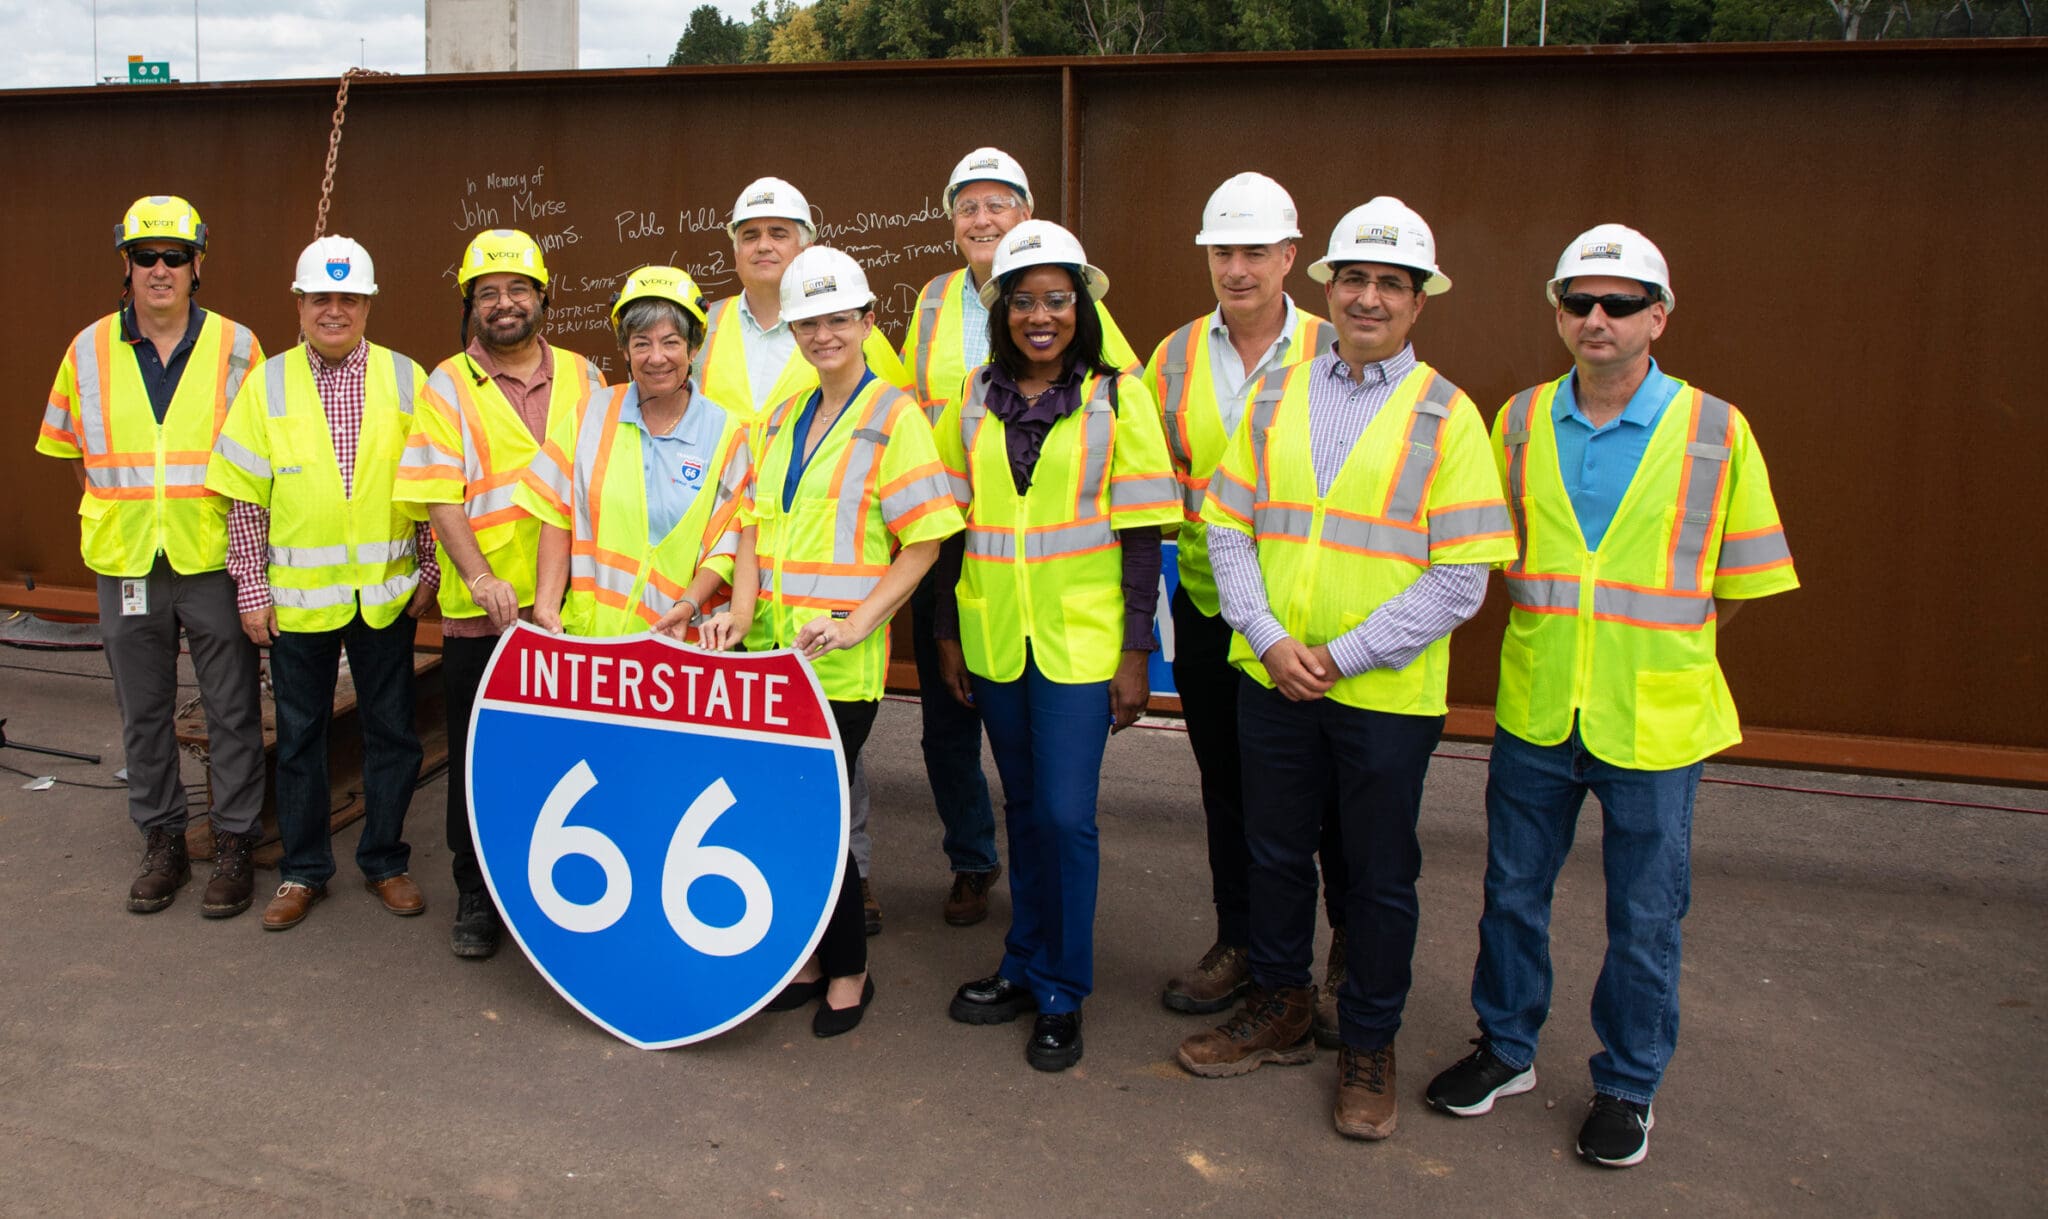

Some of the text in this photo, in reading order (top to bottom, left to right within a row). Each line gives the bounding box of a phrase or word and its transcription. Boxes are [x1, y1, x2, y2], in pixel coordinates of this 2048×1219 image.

[487, 172, 527, 195] Memory
[531, 165, 545, 186] of
[453, 191, 567, 231] John Morse
[615, 210, 665, 243] Pablo
[870, 196, 946, 230] Marsde
[857, 250, 901, 270] enate
[580, 276, 616, 292] SMITH
[547, 303, 606, 320] DISTRICT
[685, 468, 697, 478] 66
[519, 647, 790, 727] INTERSTATE
[528, 758, 773, 957] 66
